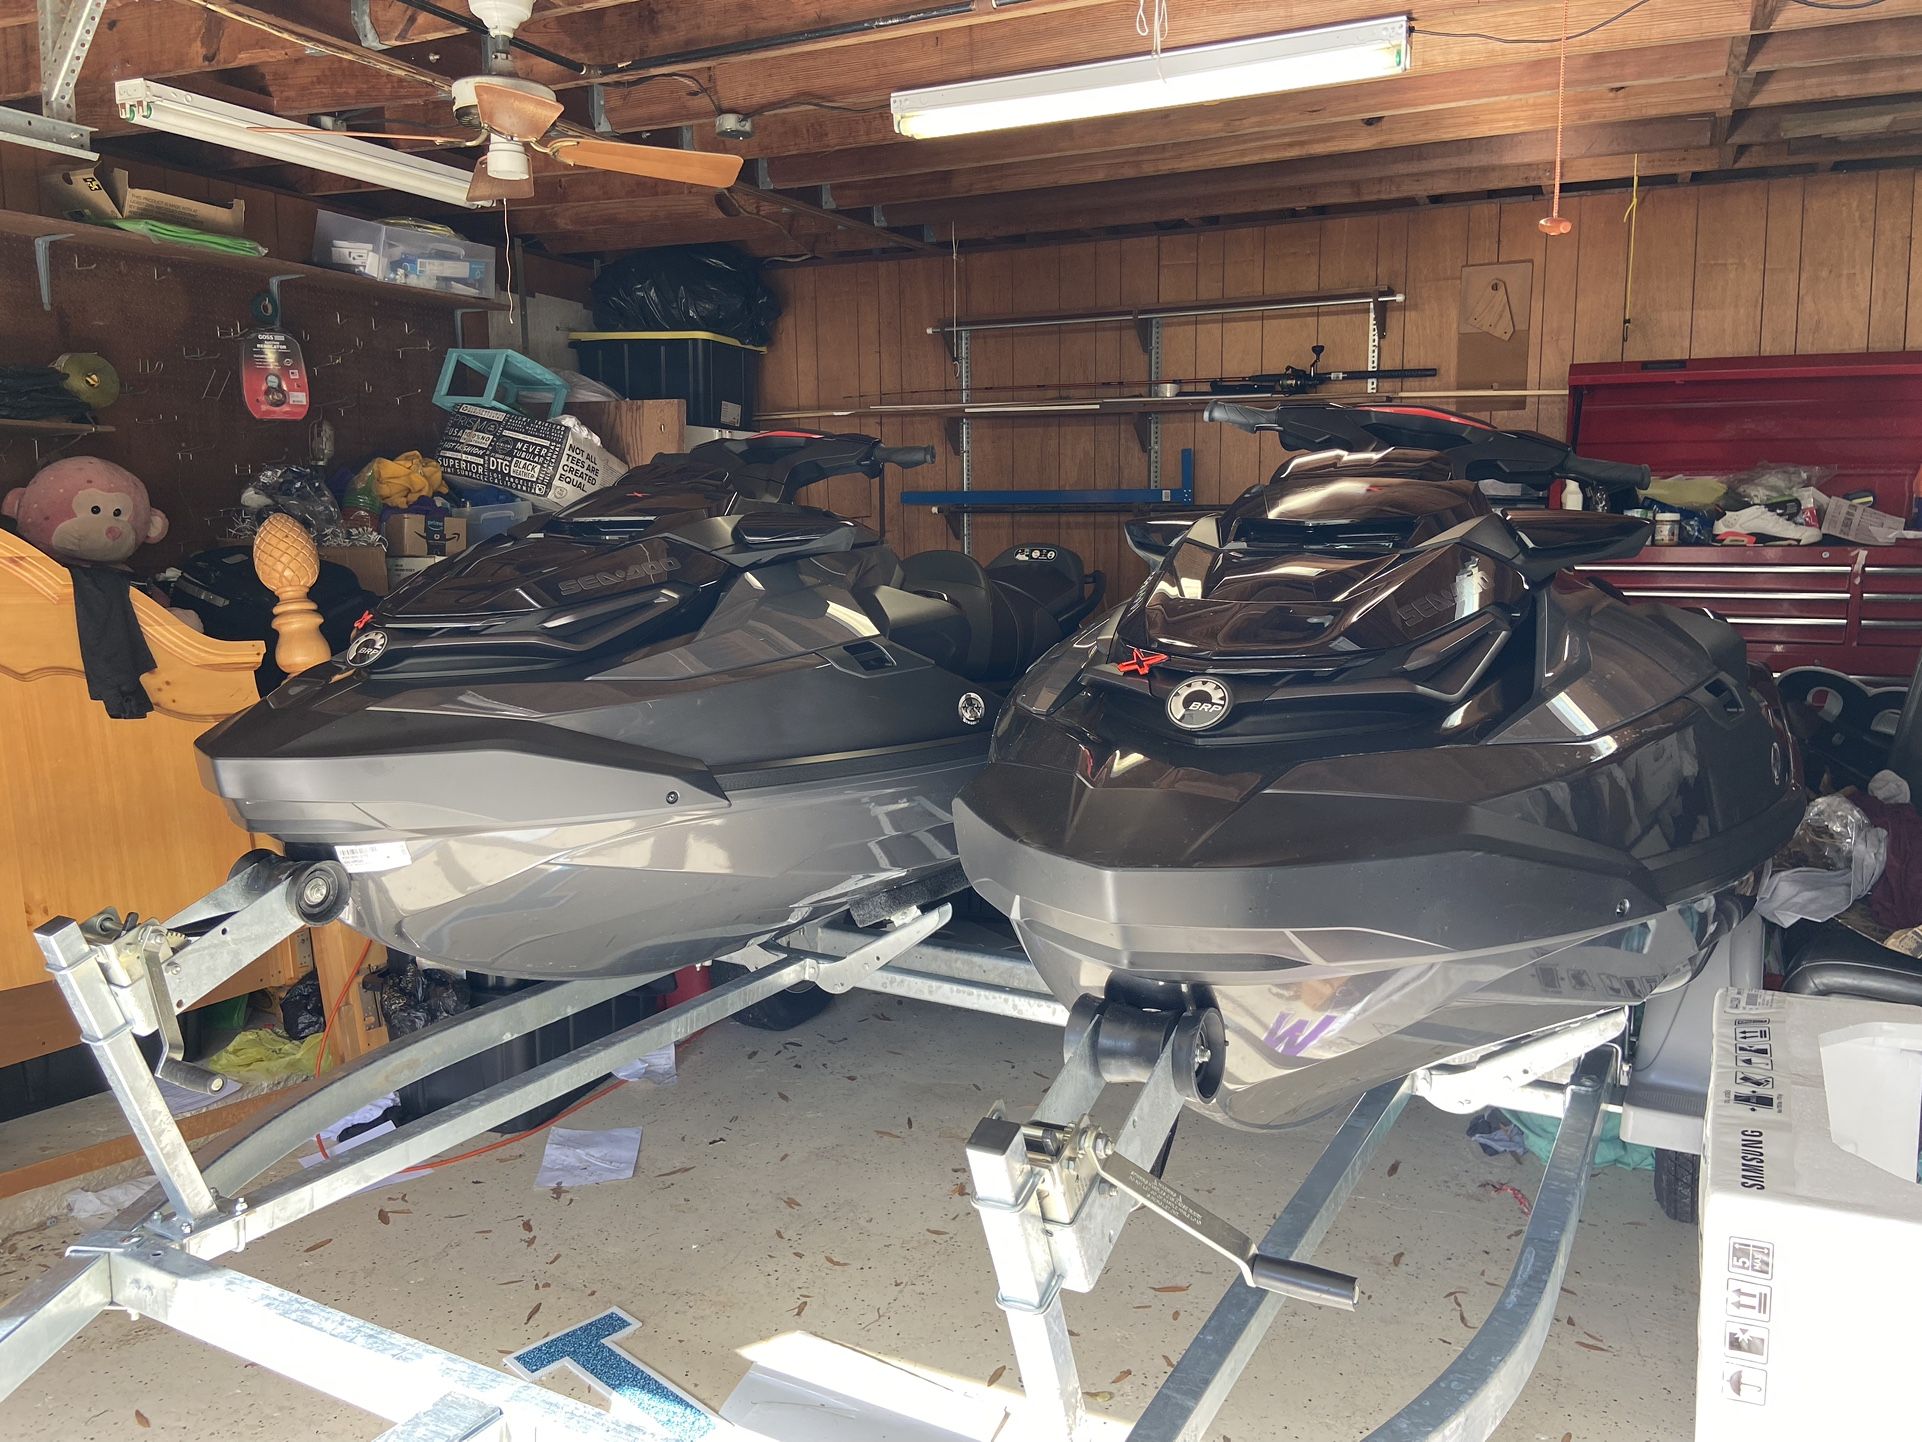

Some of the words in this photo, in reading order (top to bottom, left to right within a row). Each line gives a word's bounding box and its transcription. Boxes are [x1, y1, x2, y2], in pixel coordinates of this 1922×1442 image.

[512, 449, 544, 464] TUBULAR
[515, 441, 548, 456] NEVER
[567, 443, 585, 456] NOT
[586, 453, 597, 466] ALL
[438, 457, 484, 475] SUPERIOR
[489, 457, 510, 474] DTG
[513, 460, 538, 473] BLACK
[566, 453, 586, 469] TEES
[586, 464, 600, 477] ARE
[562, 464, 597, 486] CREATED
[489, 476, 536, 493] CALIFORNIA
[358, 647, 379, 655] BRP
[1188, 701, 1223, 713] BRP
[1740, 1129, 1765, 1191] SAMSUNG
